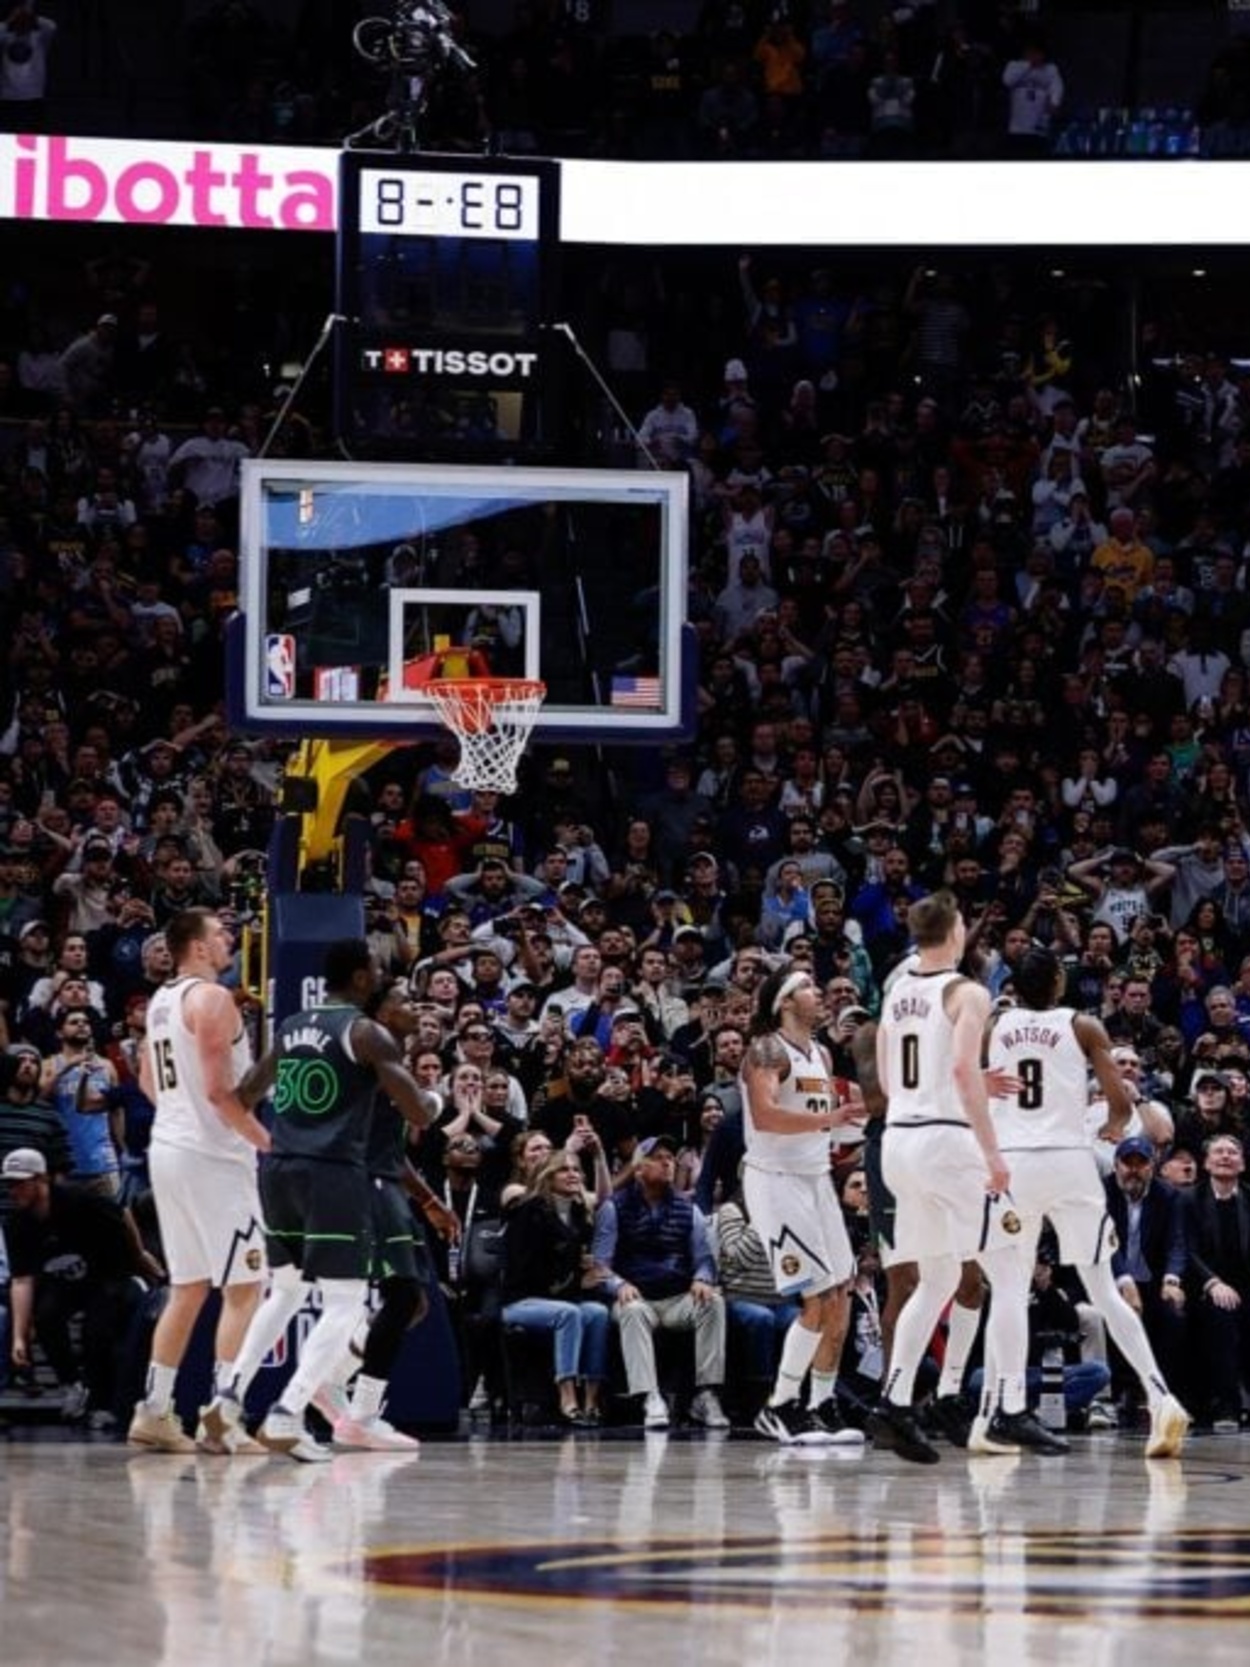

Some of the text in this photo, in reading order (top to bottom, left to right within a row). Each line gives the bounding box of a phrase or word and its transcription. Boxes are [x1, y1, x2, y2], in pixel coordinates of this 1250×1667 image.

[15, 134, 336, 230] ibotta
[412, 350, 538, 376] TISSOT
[153, 1037, 178, 1092] 15
[902, 1033, 919, 1090] 0
[1001, 1025, 1062, 1049] WATSON
[274, 1058, 339, 1115] 30
[1018, 1058, 1044, 1110] 8
